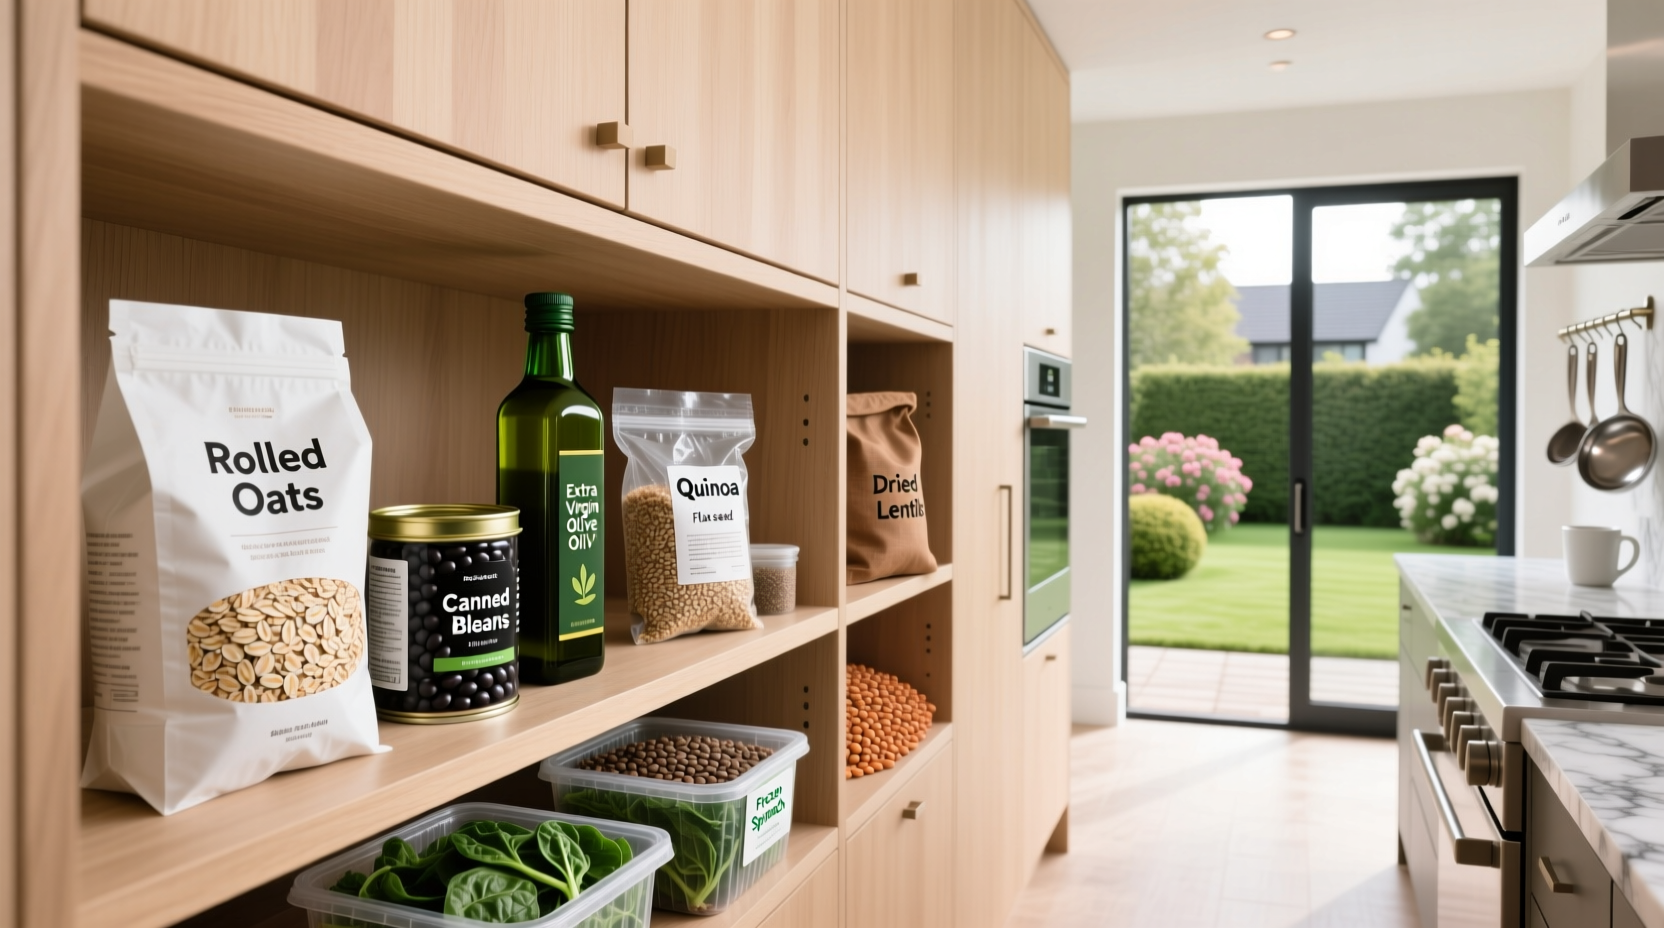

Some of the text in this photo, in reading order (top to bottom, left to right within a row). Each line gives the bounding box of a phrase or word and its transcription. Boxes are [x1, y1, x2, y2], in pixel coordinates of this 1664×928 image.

[204, 438, 327, 475] Rolled
[566, 483, 598, 498] Extra
[676, 477, 740, 501] Quinoa
[873, 473, 918, 495] Dried
[232, 482, 324, 517] Oats
[565, 499, 600, 519] Virgin
[442, 586, 510, 613] Canned
[452, 613, 510, 636] Bleans
